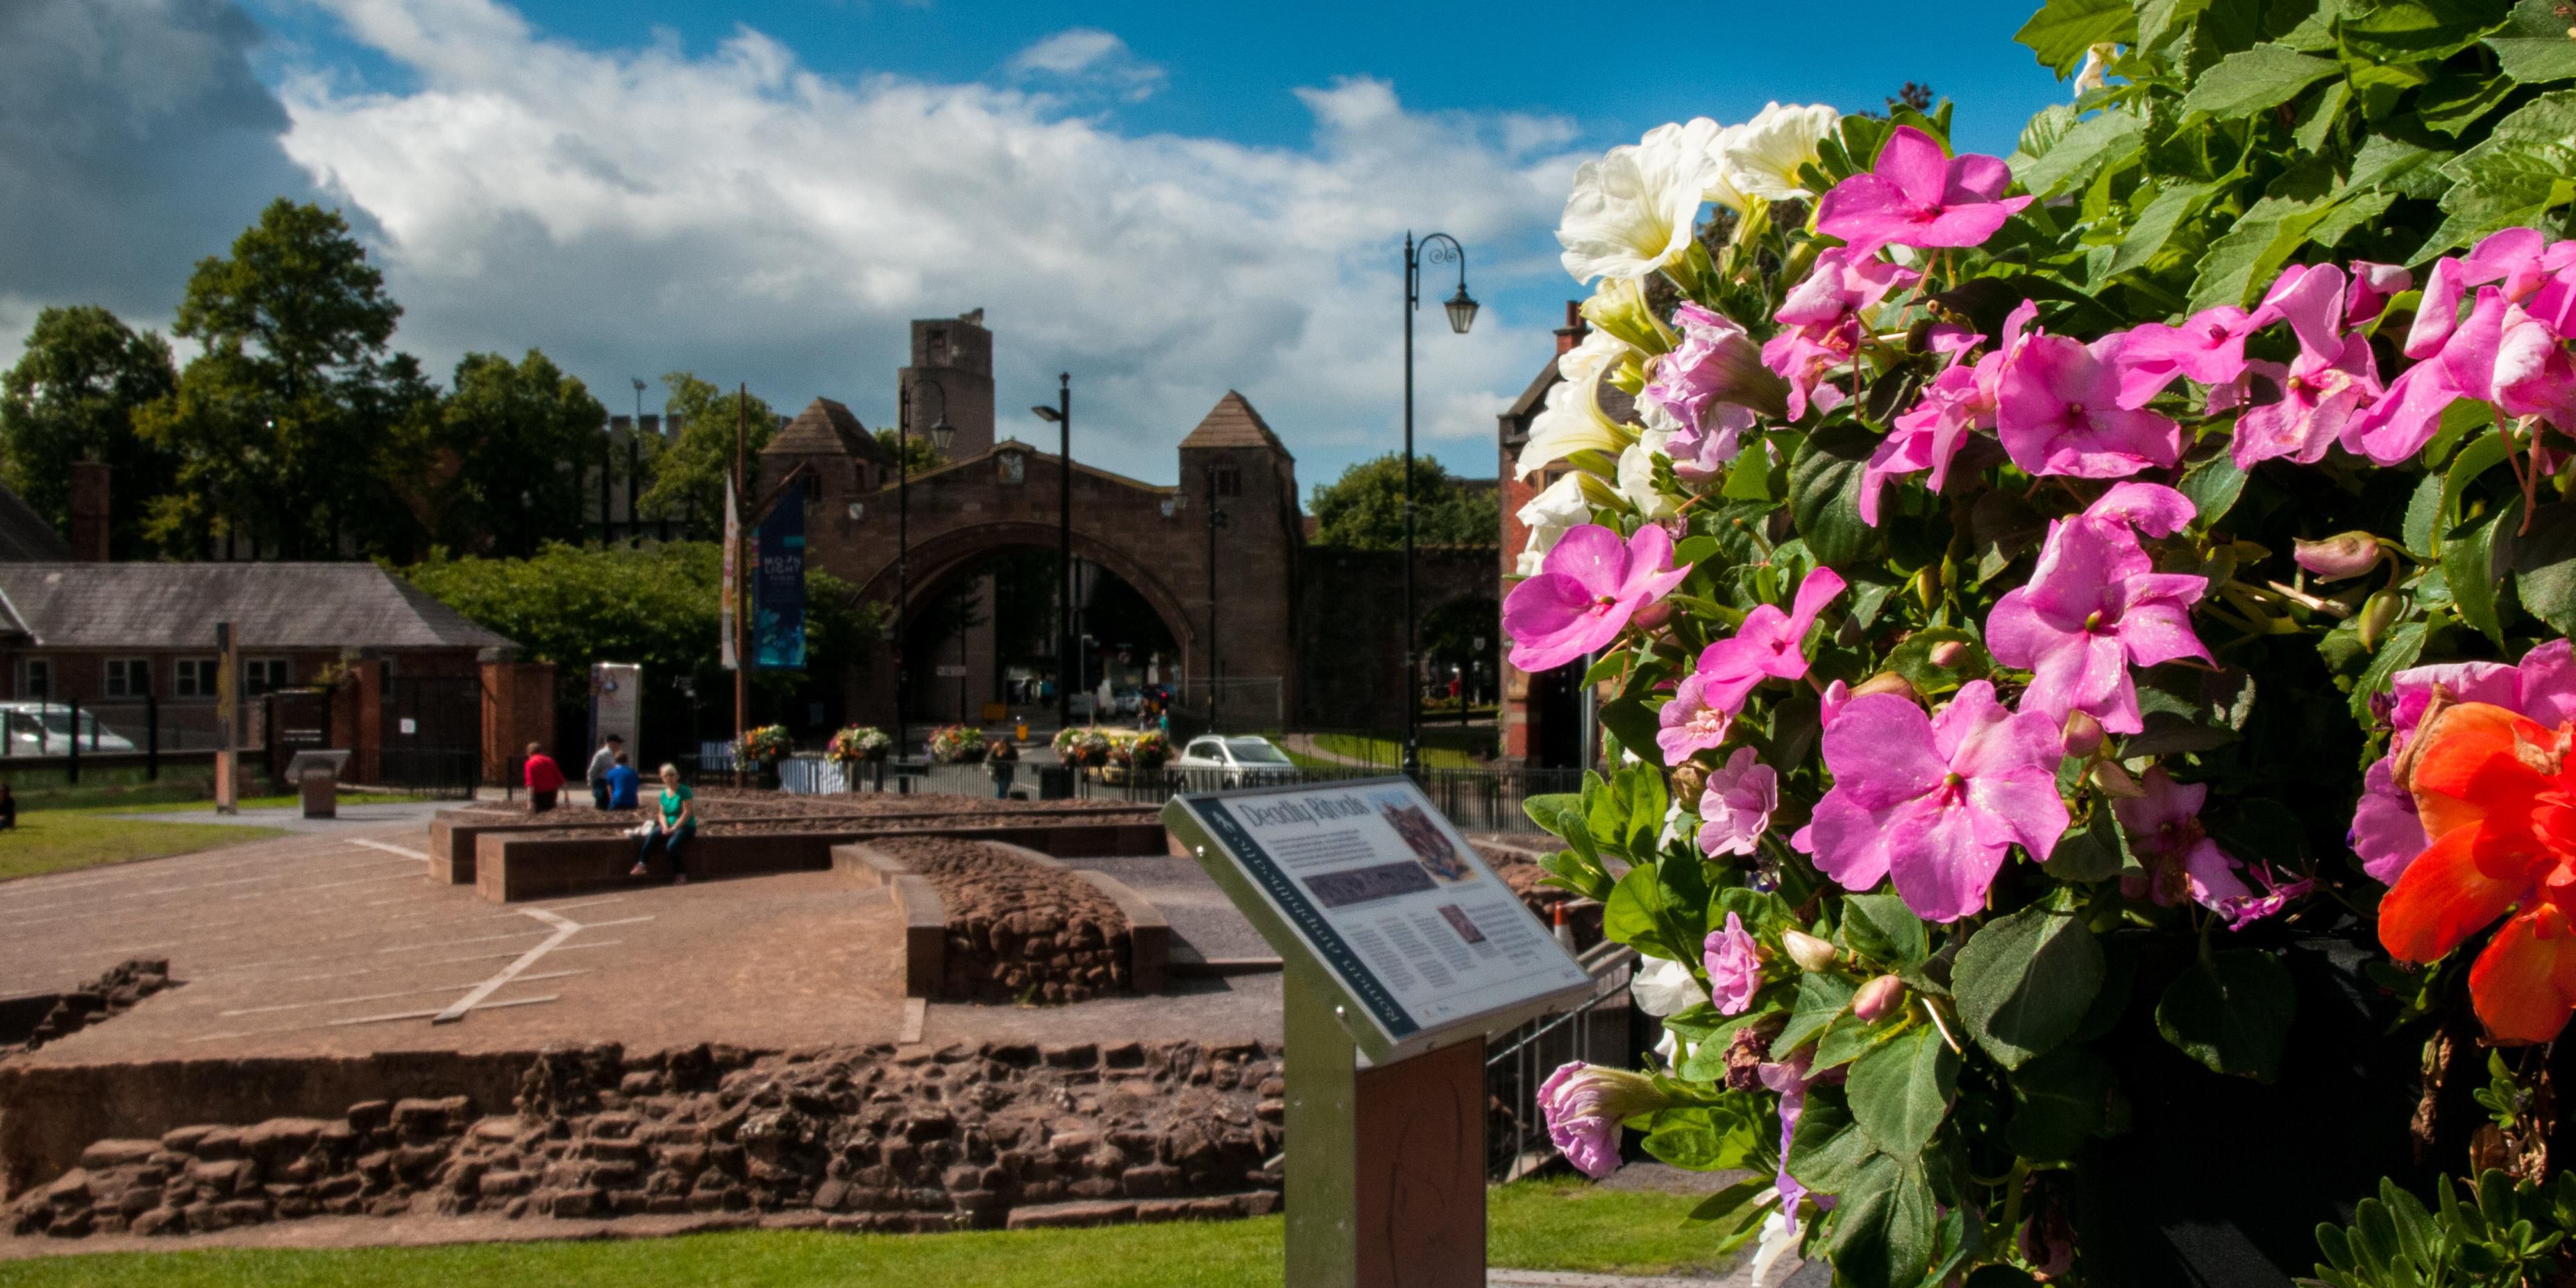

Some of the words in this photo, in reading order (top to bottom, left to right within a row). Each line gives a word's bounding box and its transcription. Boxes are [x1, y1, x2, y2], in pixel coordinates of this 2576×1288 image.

[765, 566, 799, 574] LIGHT
[1238, 799, 1320, 827] Deadly
[1305, 794, 1370, 821] Rituals
[1231, 836, 1342, 954] Amphitheatre
[1340, 959, 1401, 1022] Roman
